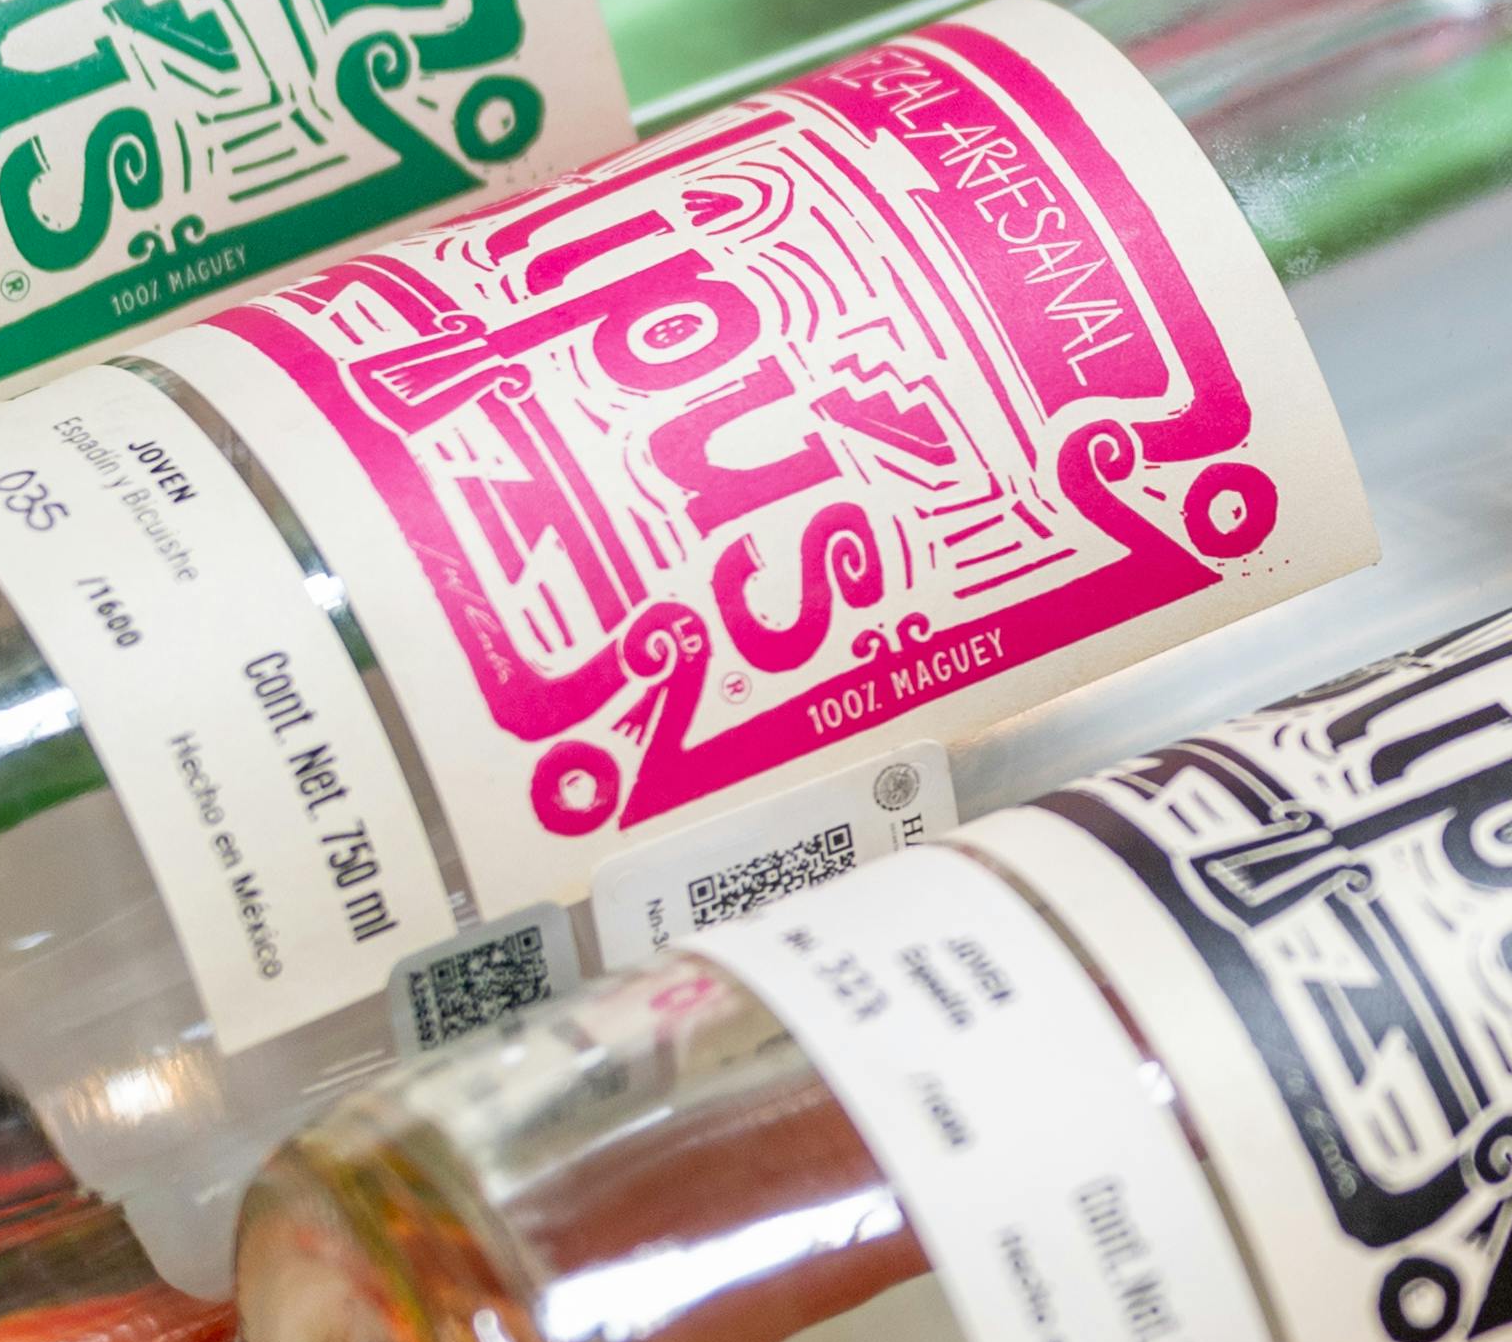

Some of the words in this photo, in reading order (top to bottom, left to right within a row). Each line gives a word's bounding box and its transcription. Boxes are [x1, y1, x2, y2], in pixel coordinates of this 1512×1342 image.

[816, 49, 960, 130] EZCAL
[110, 277, 162, 318] 100%
[171, 248, 248, 296] MAGUEY
[51, 415, 116, 479] Espadín
[126, 439, 200, 507] JOVEN
[74, 574, 144, 652] /1600
[243, 650, 316, 746] Cont.
[805, 685, 884, 736] 100%
[890, 626, 1007, 701] MAGUEY
[289, 741, 353, 822] Net.
[169, 729, 226, 828] Hecho
[212, 831, 243, 871] en
[230, 870, 284, 982] México
[320, 817, 380, 890] 750
[343, 889, 399, 946] ml
